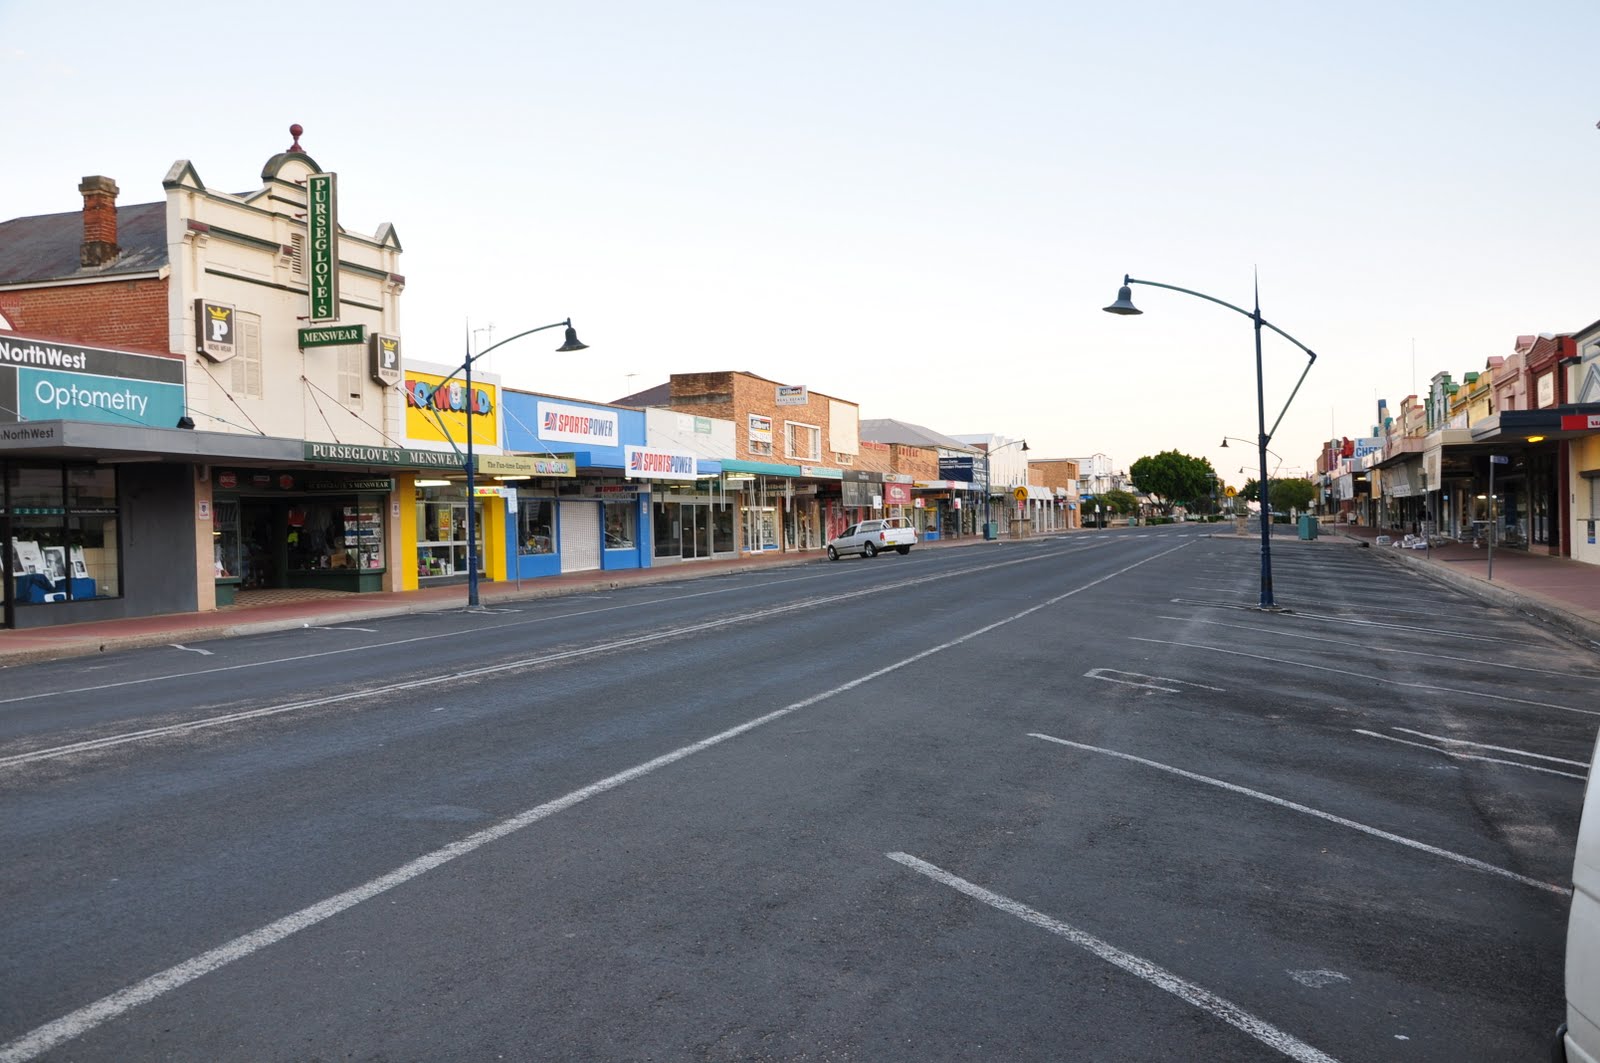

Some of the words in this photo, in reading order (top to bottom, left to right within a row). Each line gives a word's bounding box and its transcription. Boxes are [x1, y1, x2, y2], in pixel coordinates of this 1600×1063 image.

[315, 179, 329, 317] PURSEGLOVE'S
[212, 319, 229, 342] P
[303, 330, 358, 343] MENSWEAR
[0, 342, 87, 370] NorthWest
[383, 350, 395, 368] P
[35, 380, 149, 416] Optometry
[3, 426, 55, 440] NorthWest
[558, 414, 613, 438] SPORTSPOWER
[312, 444, 400, 462] PURSEGLOVE'S
[643, 453, 693, 474] SPORTSPOWER
[354, 481, 389, 489] MENSWEAR
